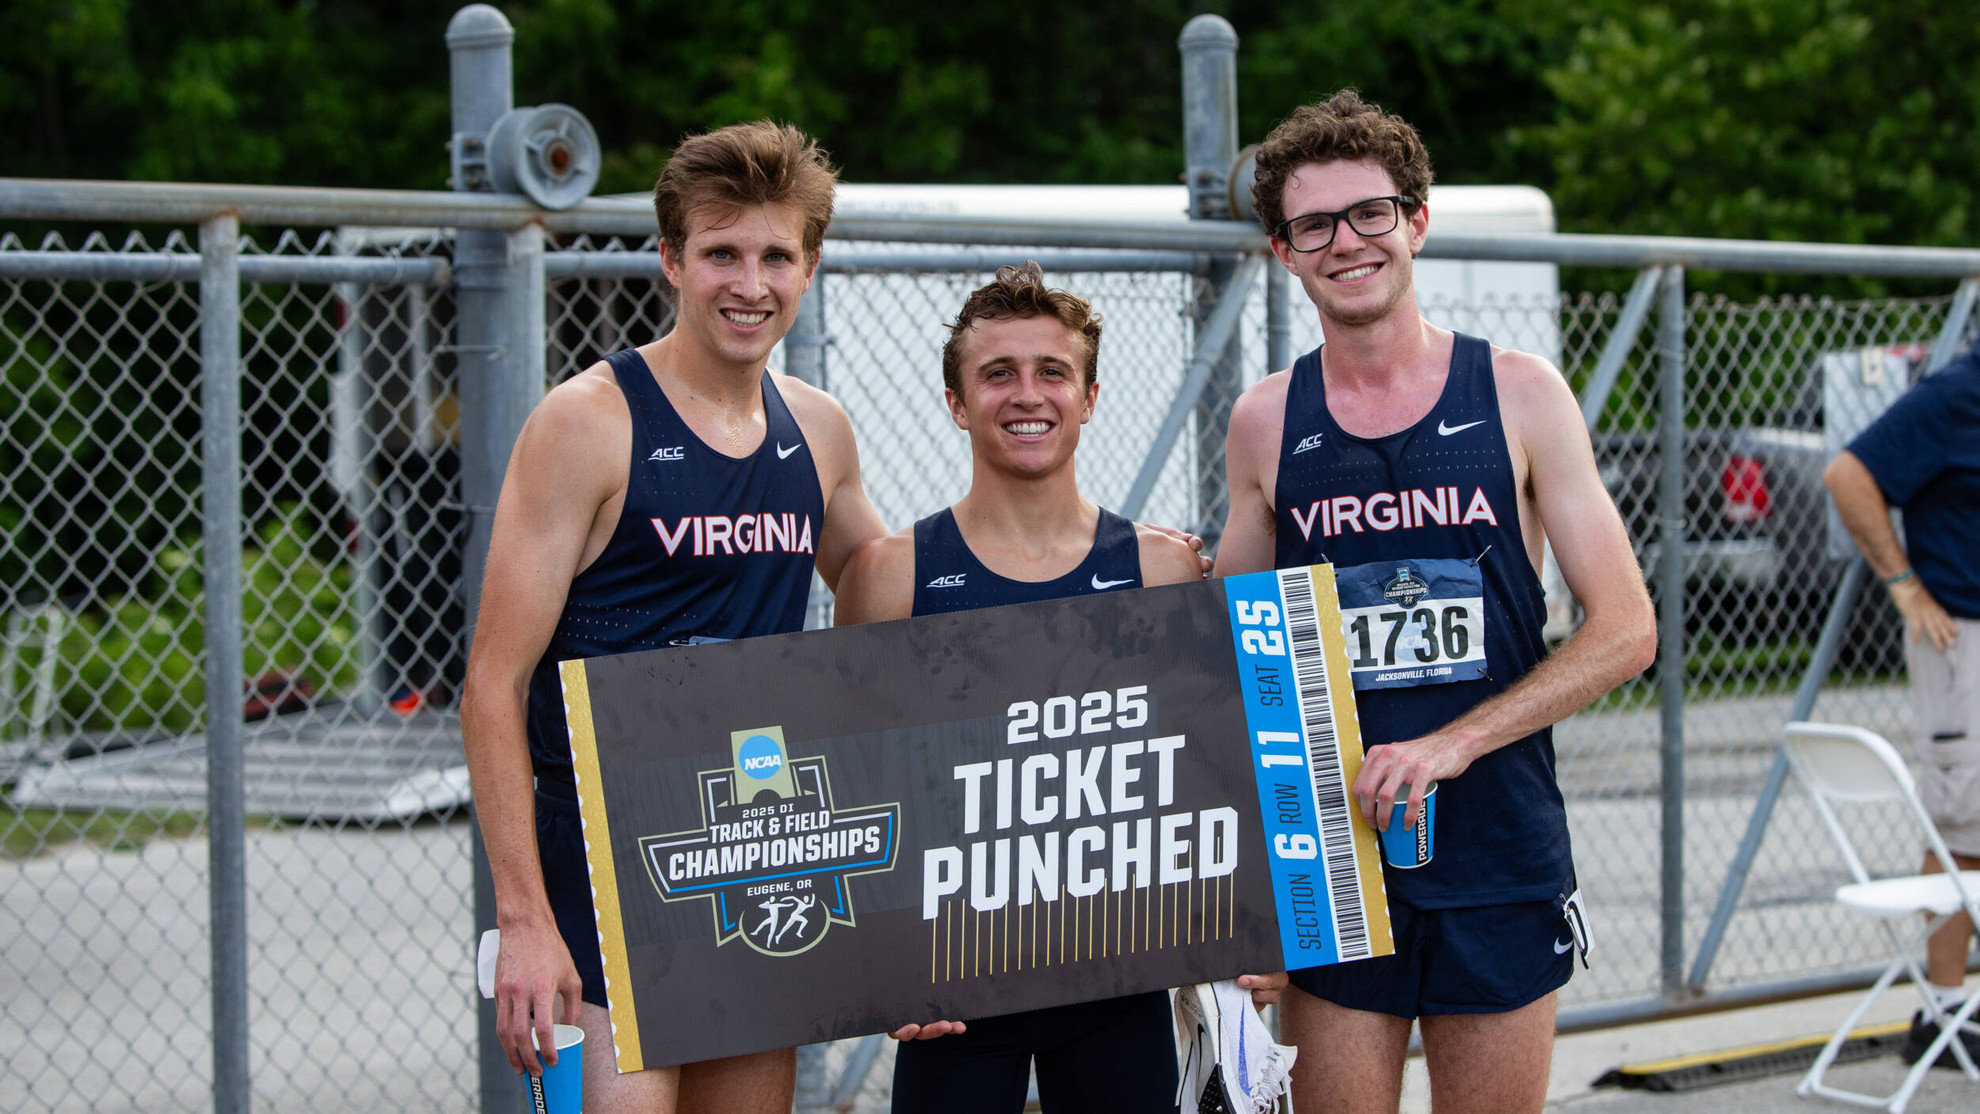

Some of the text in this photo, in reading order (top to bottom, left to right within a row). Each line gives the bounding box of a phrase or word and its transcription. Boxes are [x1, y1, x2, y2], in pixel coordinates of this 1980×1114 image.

[648, 446, 684, 461] ACC
[1293, 433, 1323, 455] ACC
[1291, 486, 1498, 542] VIRGINIA
[650, 512, 814, 557] VIRGINIA
[926, 573, 967, 588] ACC
[1350, 605, 1469, 668] 1736
[1375, 667, 1452, 682] JACKSONVILLE, FLORIDA
[1007, 685, 1148, 744] 2025
[744, 754, 782, 771] NCAA
[1235, 600, 1322, 950] SECTION 6 ROW 11 SEAT 25
[954, 734, 1186, 834] TICKET
[709, 810, 830, 844] TRACK & FIELD
[742, 803, 795, 819] 2025 DI
[669, 825, 880, 881] CHAMPIONSHIPS
[923, 806, 1239, 920] PUNCHED
[747, 879, 812, 896] EUGENE, OR
